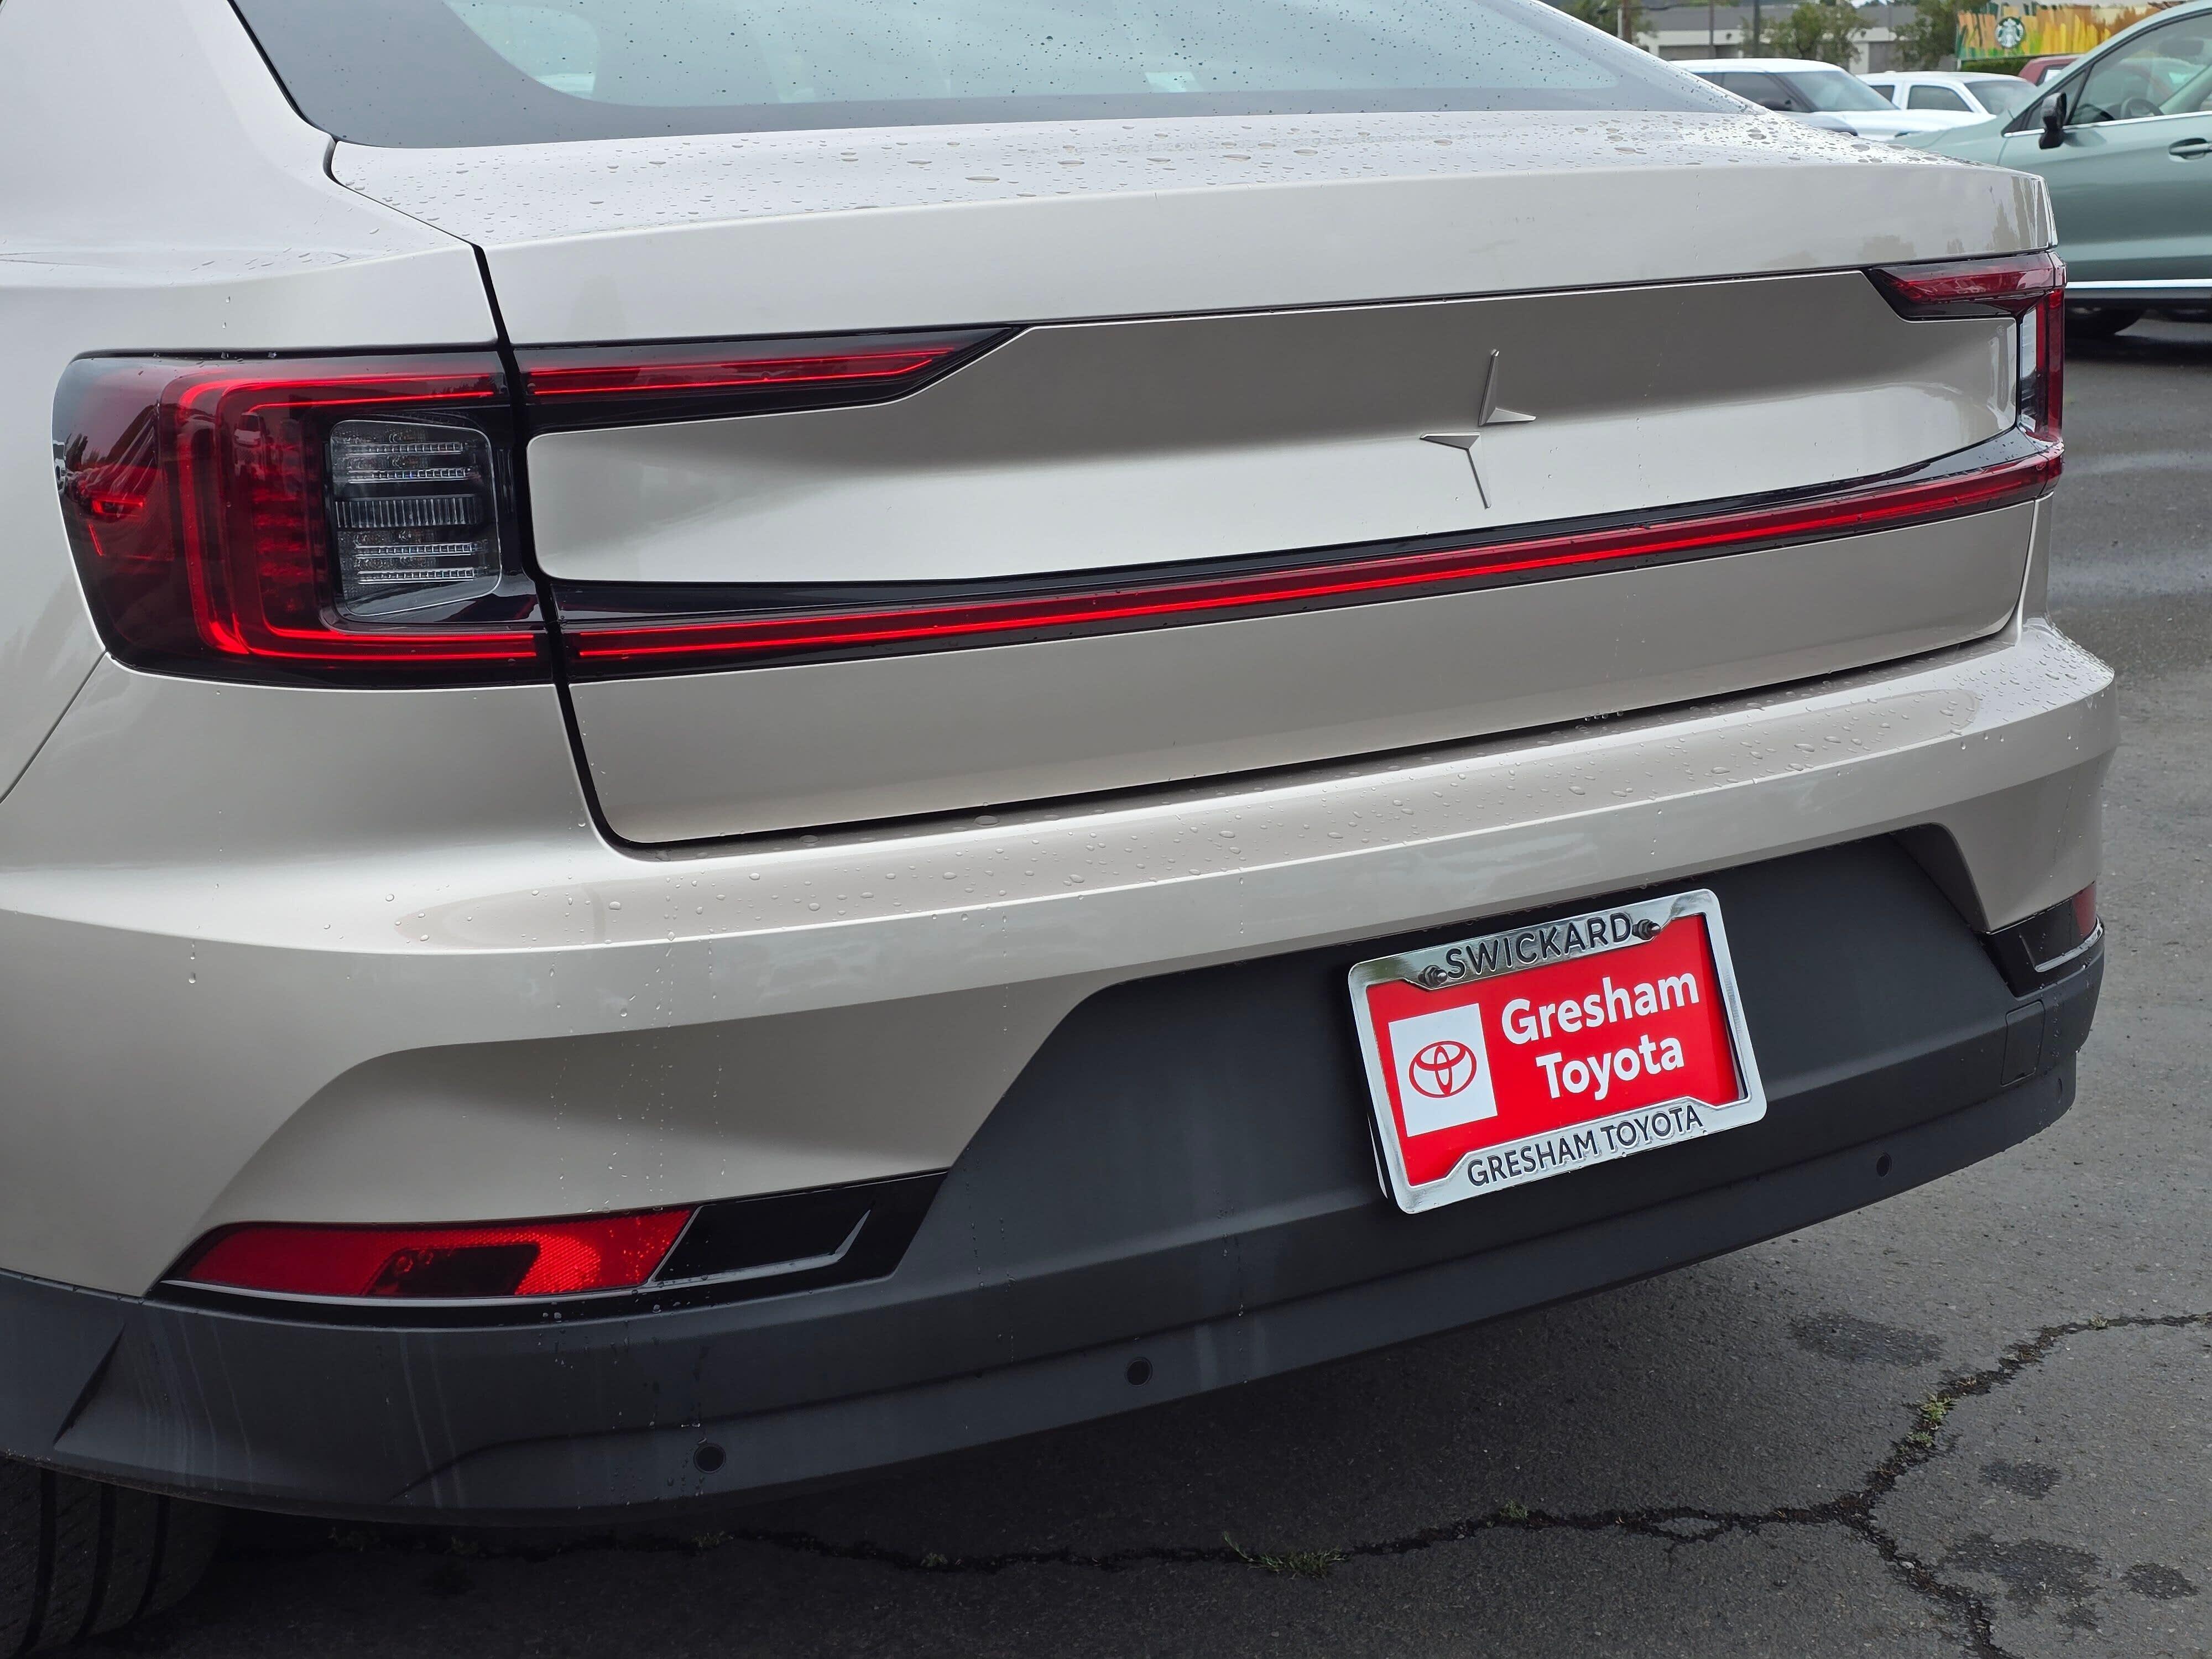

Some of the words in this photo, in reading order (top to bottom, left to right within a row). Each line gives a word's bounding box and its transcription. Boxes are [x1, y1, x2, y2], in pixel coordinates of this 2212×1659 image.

[1446, 913, 1632, 980] SWICKARD
[1502, 972, 1699, 1045] Gresham
[1537, 1034, 1684, 1100] Toyota
[1468, 1130, 1598, 1187] GRESHAM
[1601, 1105, 1704, 1151] TOYOTA
